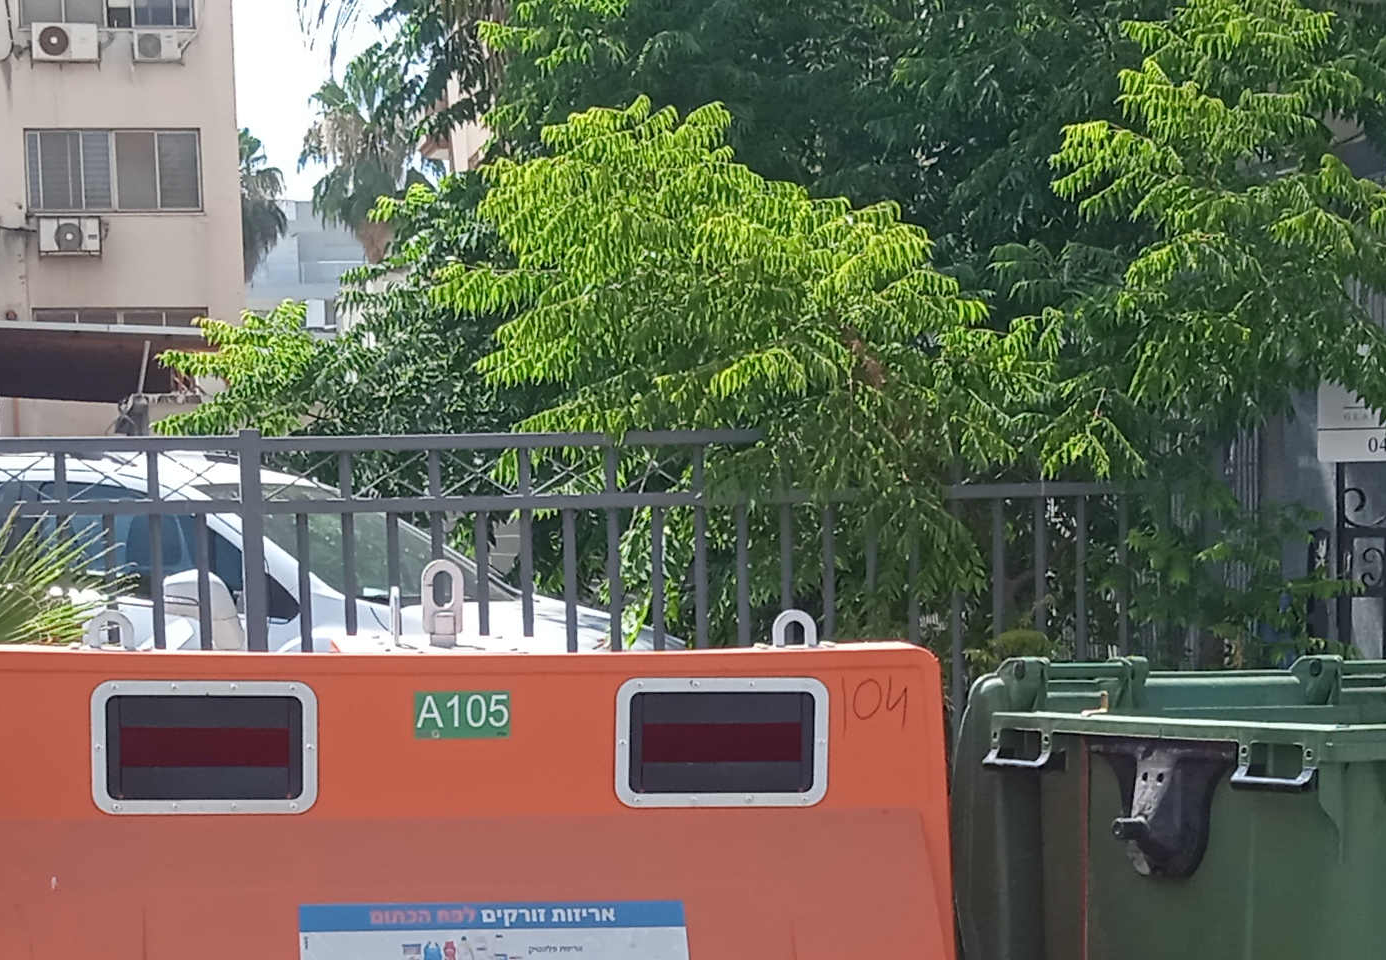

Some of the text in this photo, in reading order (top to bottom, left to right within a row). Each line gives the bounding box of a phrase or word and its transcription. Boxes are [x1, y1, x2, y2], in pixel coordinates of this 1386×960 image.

[416, 693, 510, 729] A105
[370, 907, 616, 927] אריזות זורקים לפח הכתום
